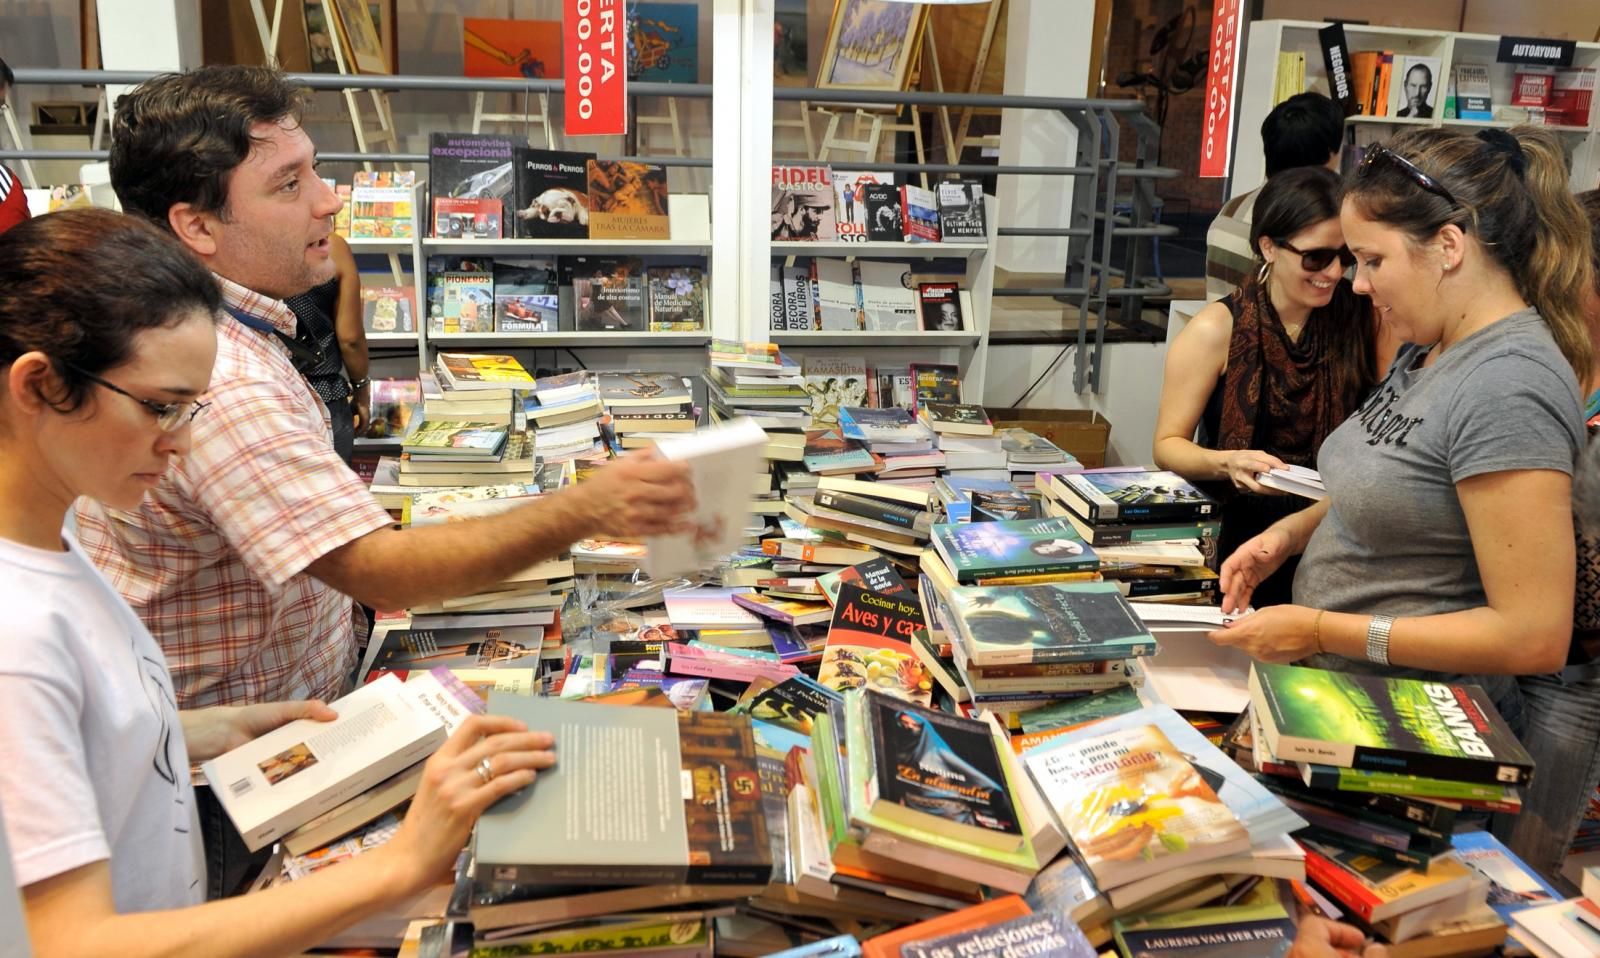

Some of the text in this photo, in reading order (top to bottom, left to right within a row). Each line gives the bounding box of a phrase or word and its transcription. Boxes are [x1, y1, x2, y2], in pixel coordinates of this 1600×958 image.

[1511, 43, 1562, 60] AUTOAYUDA
[1329, 45, 1349, 100] NEGOCIOS
[526, 161, 552, 171] PERROS
[559, 164, 584, 173] PERROS
[772, 167, 831, 187] FIDEL
[778, 182, 824, 191] CASTRO
[611, 216, 649, 224] MUJERES
[445, 275, 491, 284] PIONEROS
[773, 292, 783, 330] DECORA
[788, 291, 798, 330] DECORA
[796, 275, 809, 331] CON LIBROS
[807, 367, 864, 375] KAMASUTRA
[864, 566, 891, 580] Manual
[869, 575, 886, 585] de la
[874, 580, 892, 592] novia
[860, 593, 920, 616] Cocinar hoy...
[841, 602, 878, 628] Aves
[882, 617, 893, 636] y
[1423, 684, 1495, 758] BANKS
[1079, 739, 1118, 757] puede
[1089, 753, 1110, 765] por
[957, 920, 1054, 956] relaciones
[1003, 934, 1066, 958] demás
[1144, 926, 1285, 951] LAURENS VAN DER POST
